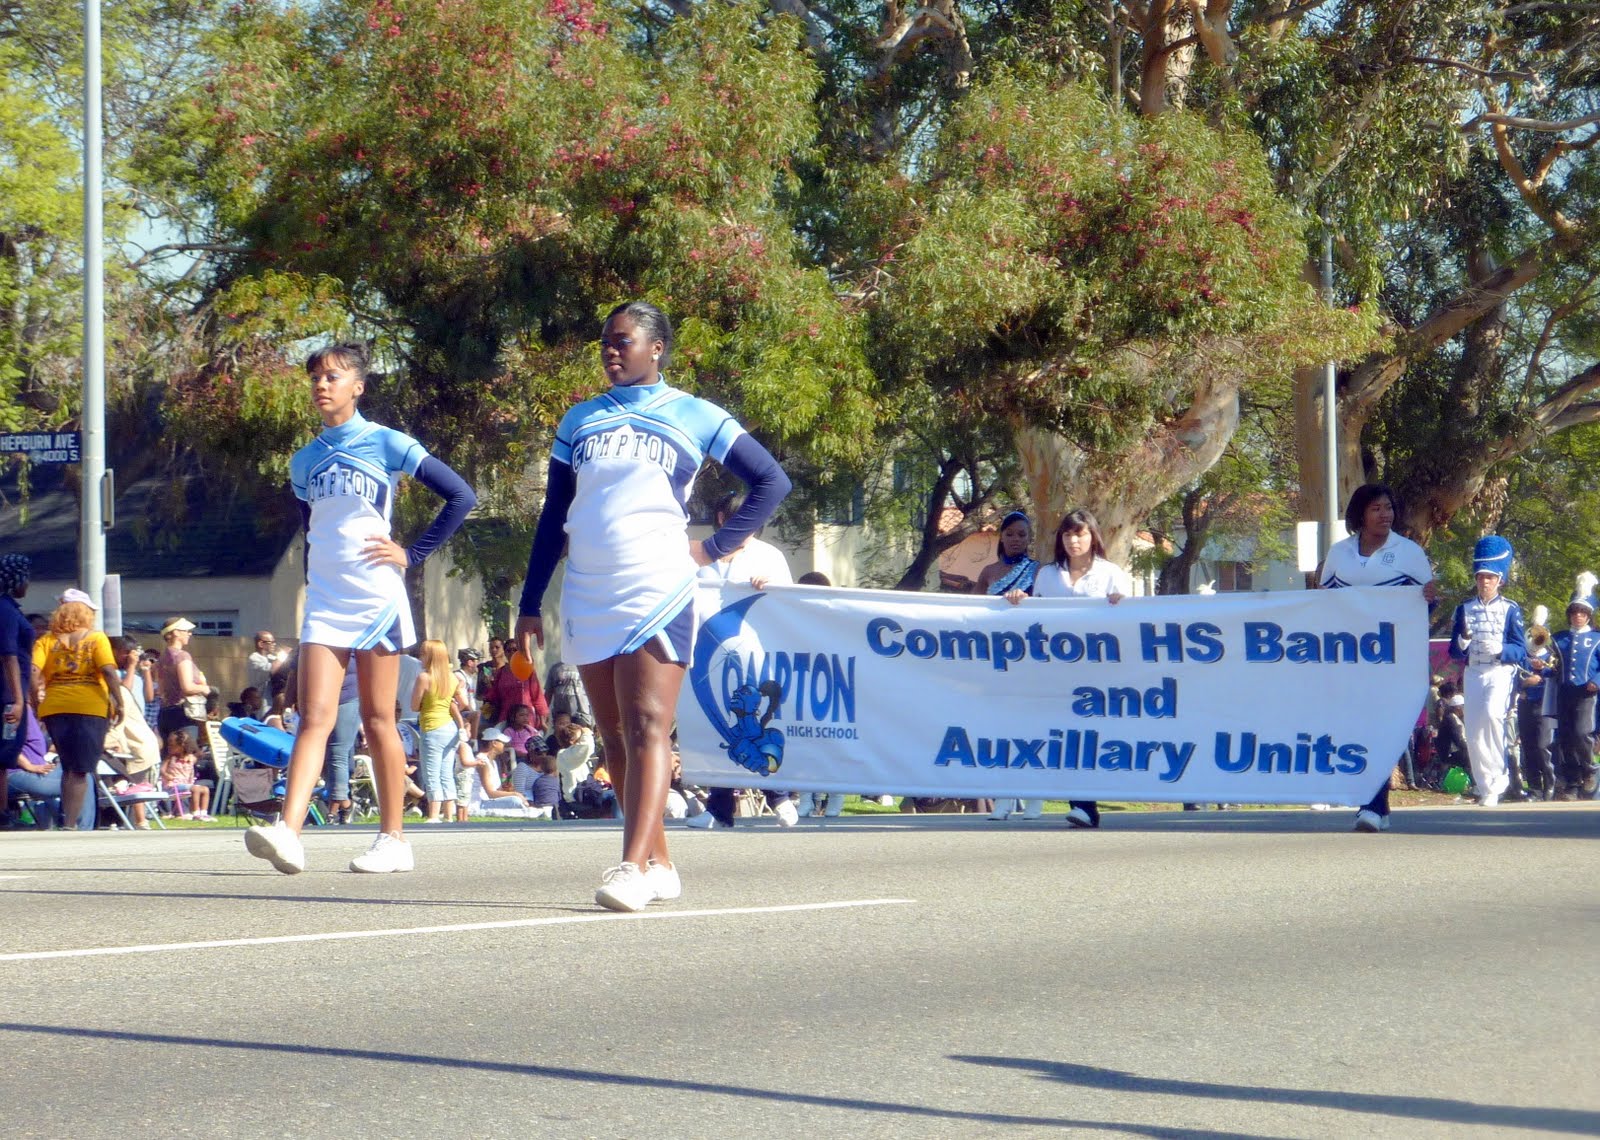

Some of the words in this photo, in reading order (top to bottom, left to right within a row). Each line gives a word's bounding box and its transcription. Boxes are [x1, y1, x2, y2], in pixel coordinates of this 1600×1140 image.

[0, 434, 52, 451] HEPBURN
[572, 431, 678, 477] COMPTON
[866, 617, 1121, 672] Compton
[1139, 621, 1225, 664] HS
[1244, 621, 1396, 664] Band
[1071, 676, 1178, 718] and
[786, 725, 813, 738] HIGH
[815, 726, 859, 740] SCHOOL
[934, 726, 1197, 783] Auxillary
[1214, 731, 1368, 775] Units
